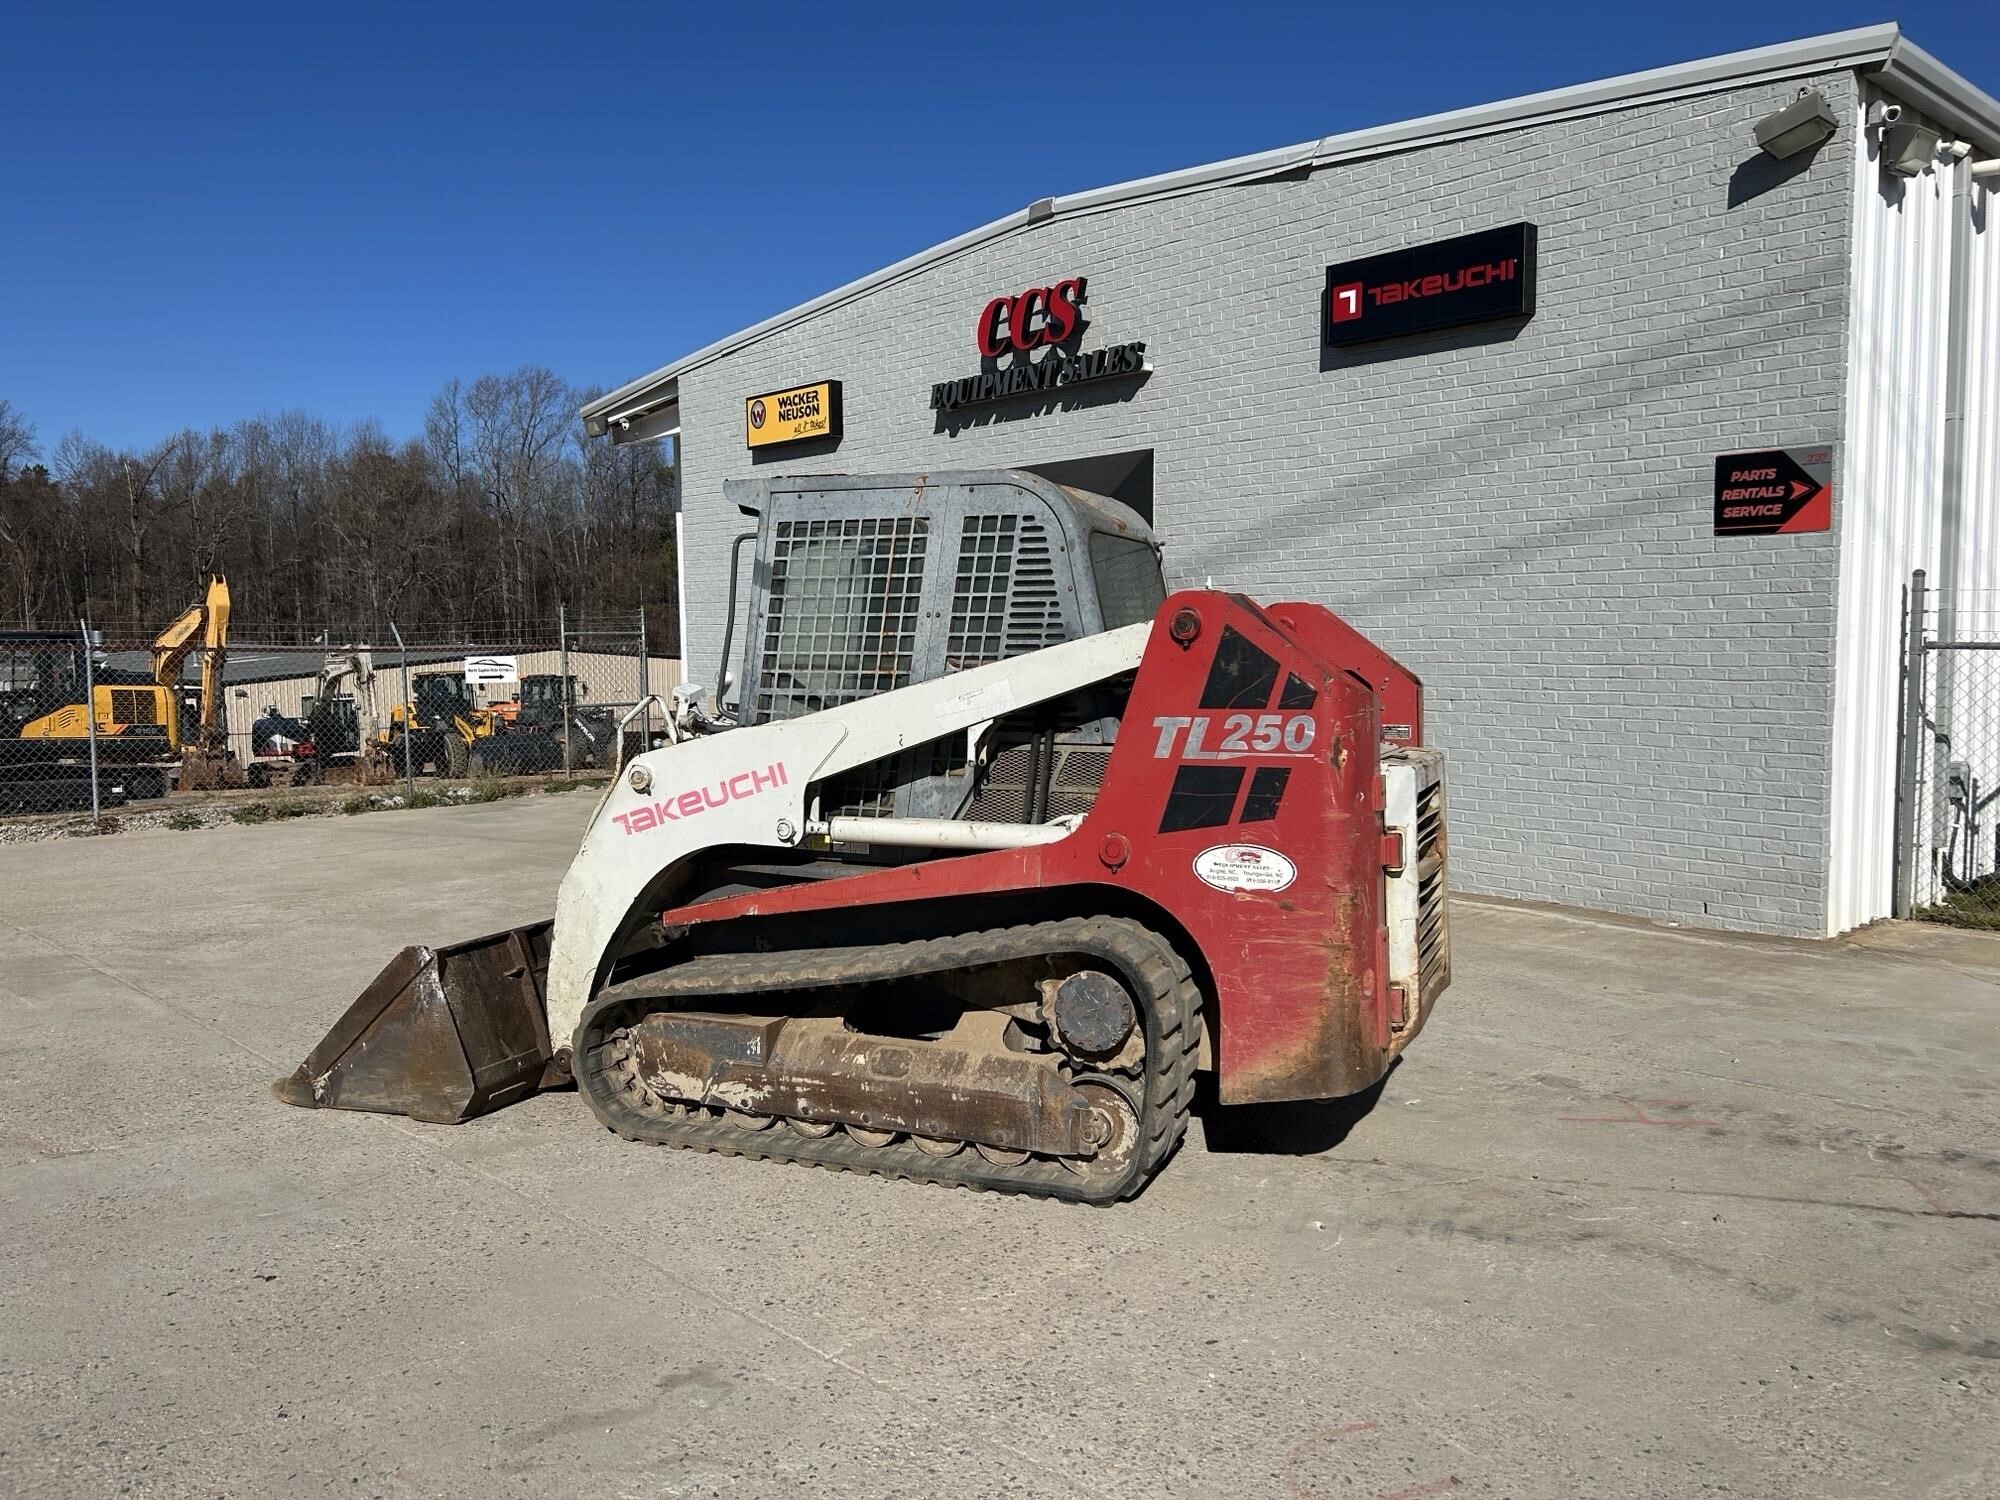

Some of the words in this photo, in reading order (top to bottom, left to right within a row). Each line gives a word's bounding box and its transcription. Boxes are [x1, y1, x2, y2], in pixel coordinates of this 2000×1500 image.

[977, 277, 1088, 358] CCS
[930, 359, 1059, 411] EQUIPMENT
[1060, 341, 1146, 385] SALES
[777, 390, 819, 409] WACKER
[778, 403, 820, 423] NEUSON
[1730, 468, 1777, 482] PARTS
[1722, 485, 1785, 500] RENTALS
[1722, 504, 1783, 518] SERVICE
[1153, 714, 1316, 760] TL250
